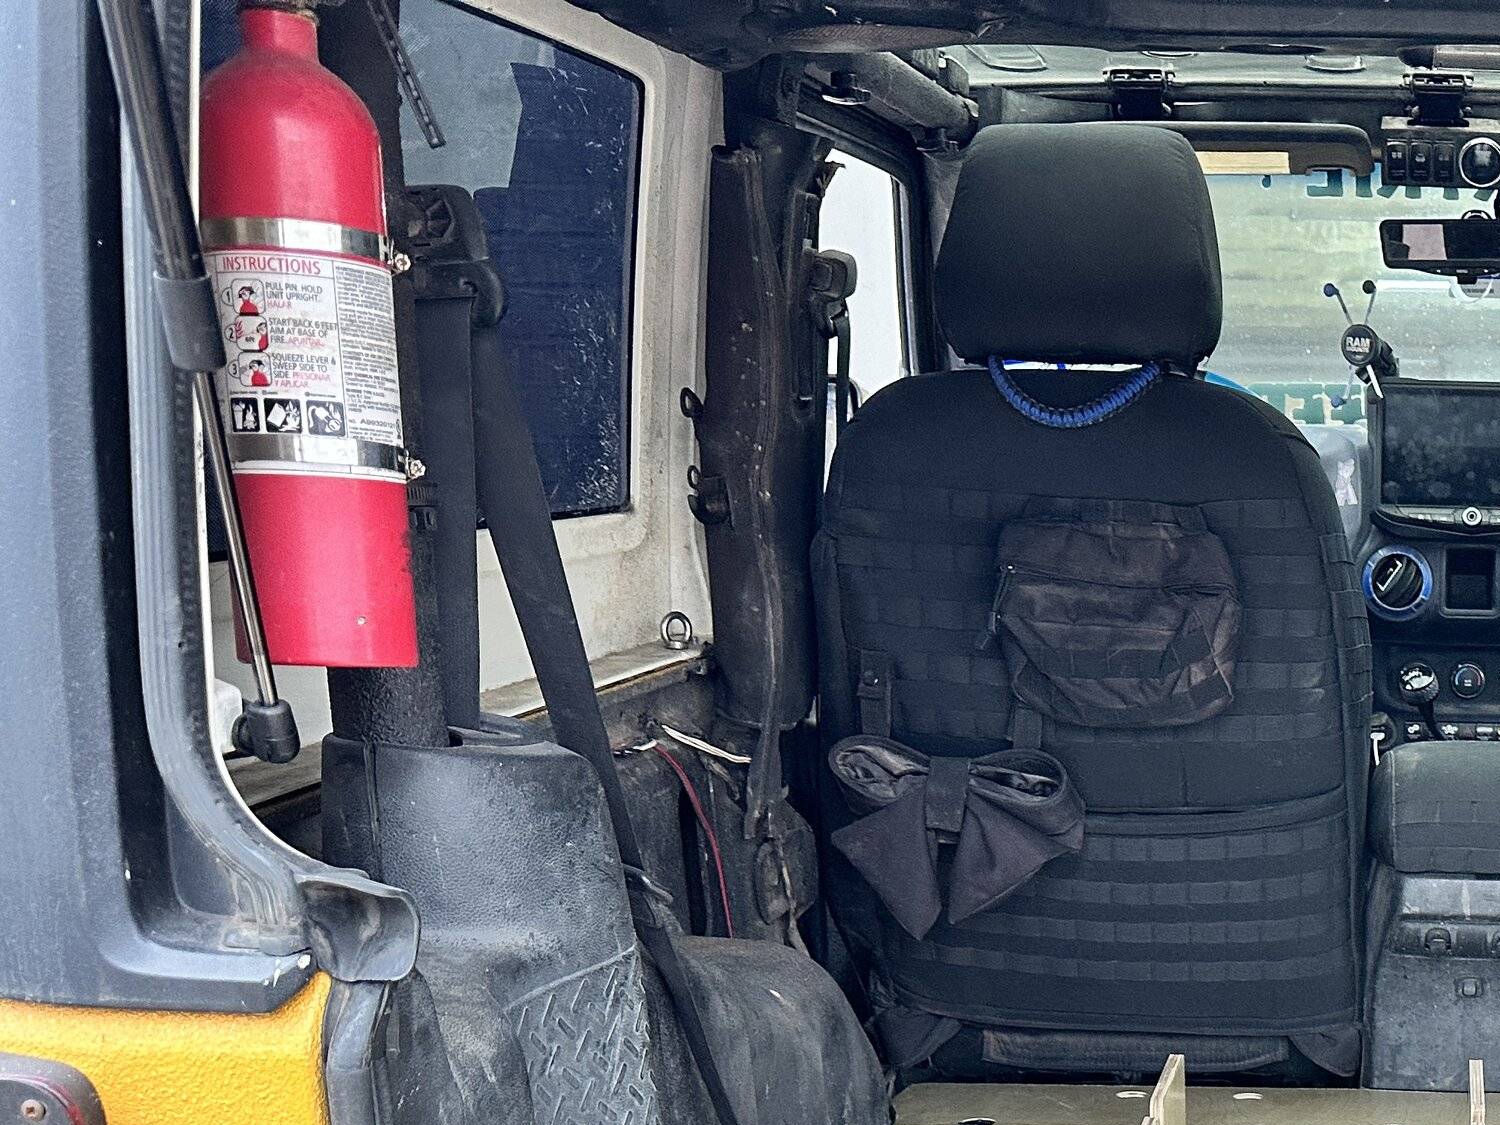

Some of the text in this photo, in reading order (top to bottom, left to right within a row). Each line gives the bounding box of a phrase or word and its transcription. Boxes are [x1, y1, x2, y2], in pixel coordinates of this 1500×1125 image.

[223, 256, 321, 275] INSTRUCTIONS
[266, 282, 283, 291] PULL
[301, 285, 323, 294] HOLD
[266, 291, 283, 300] UNIT
[268, 317, 291, 326] START
[293, 319, 313, 328] BACK
[270, 327, 328, 338] AIM AT BASE OF
[1346, 336, 1370, 347] RAM
[272, 353, 305, 362] SQUEEZE
[306, 355, 329, 364] LEVER
[273, 362, 328, 373] SWEEP SIDE TO
